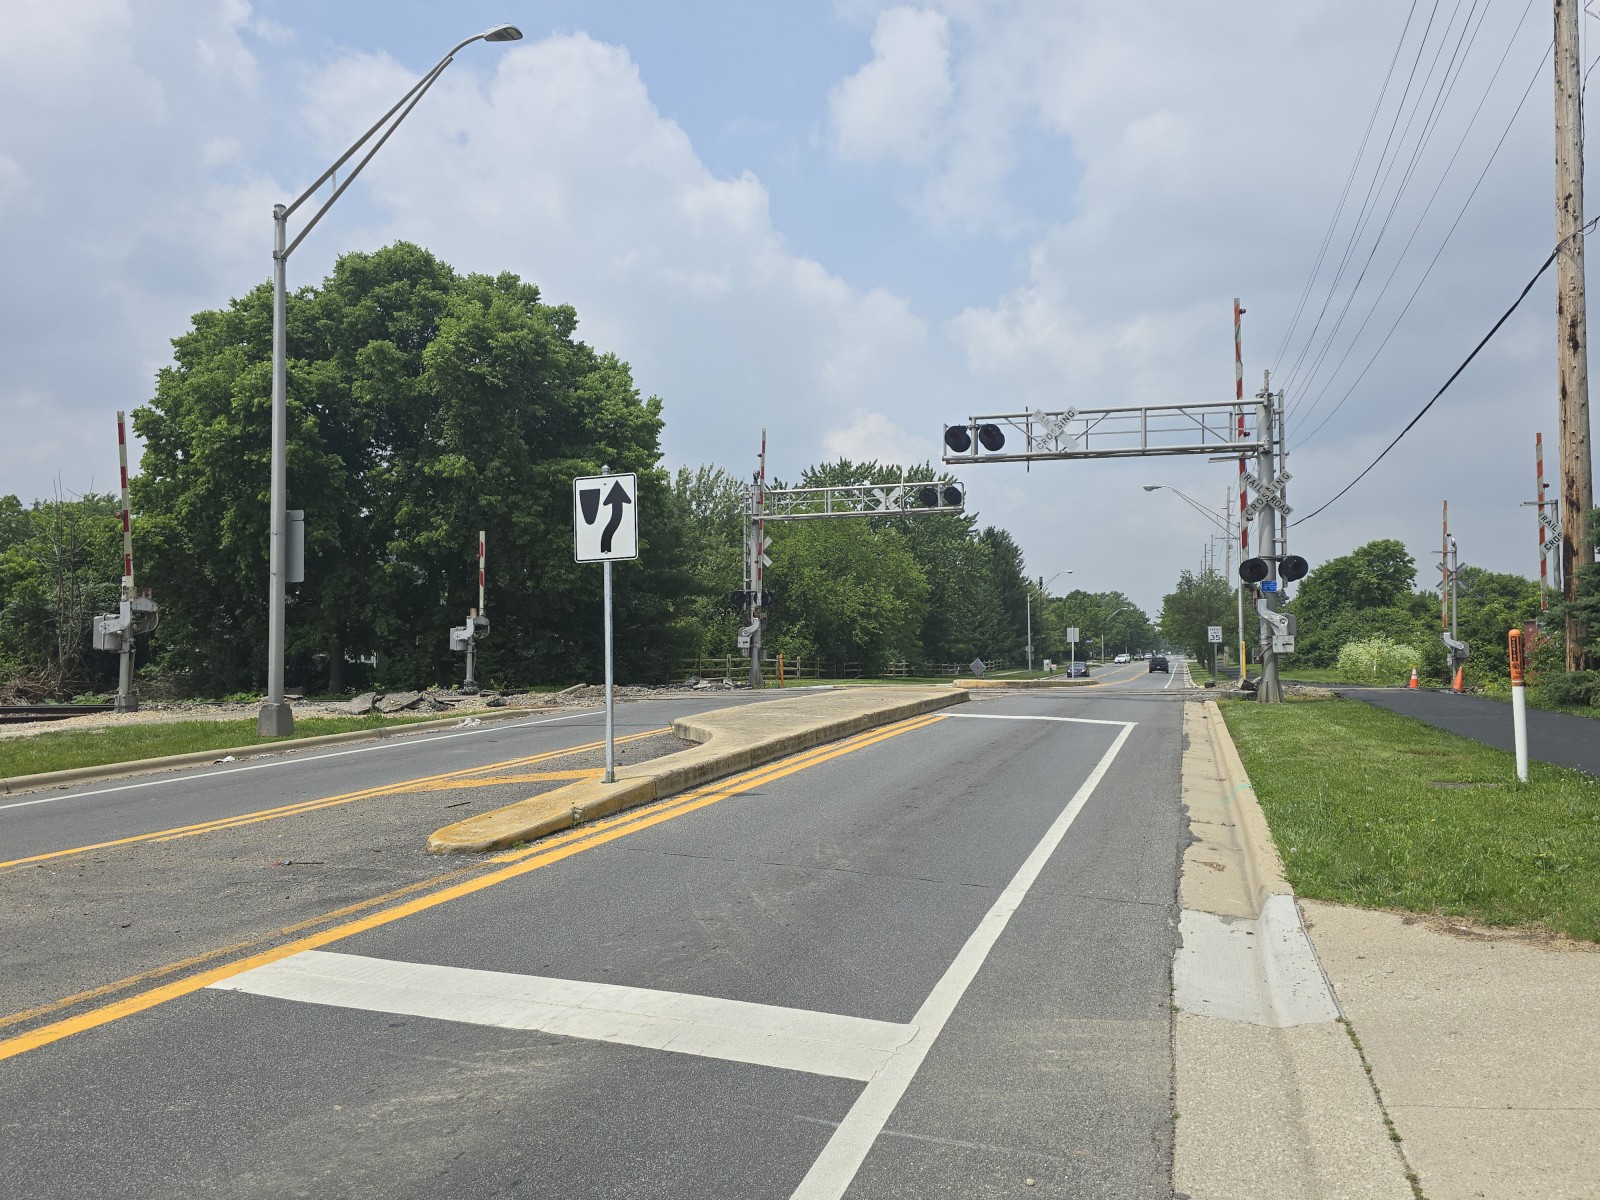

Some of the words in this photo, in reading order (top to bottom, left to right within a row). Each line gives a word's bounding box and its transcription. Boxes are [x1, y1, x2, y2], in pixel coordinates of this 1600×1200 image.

[1243, 473, 1263, 494] RAIL
[1269, 495, 1291, 515] ROAD
[1245, 472, 1290, 516] CROSSING
[1540, 515, 1558, 532] RAIL
